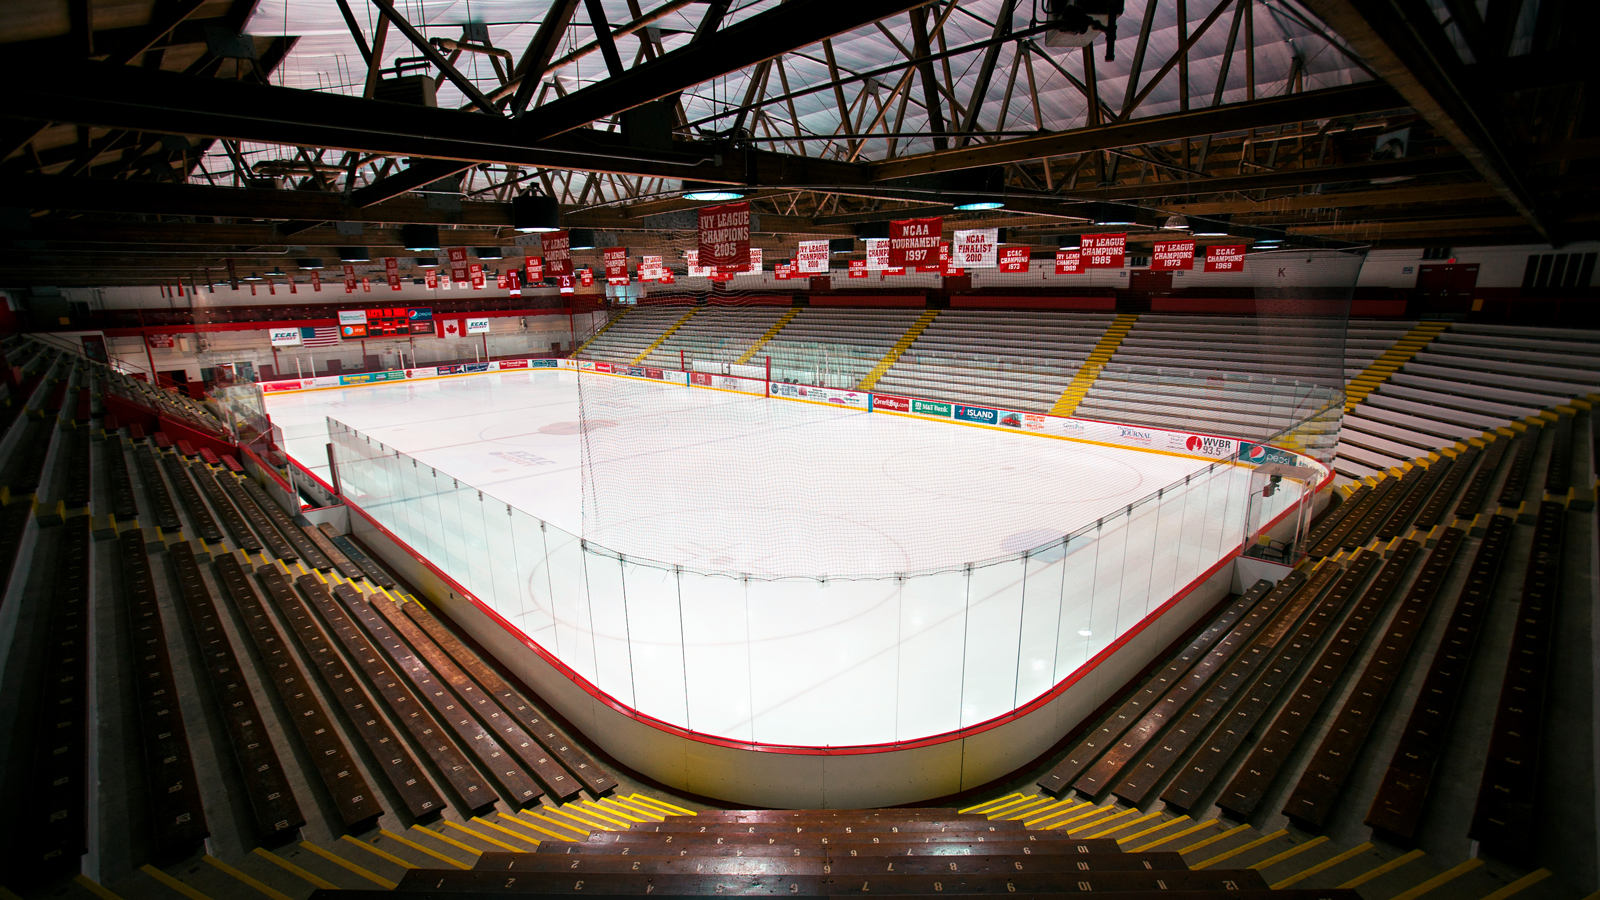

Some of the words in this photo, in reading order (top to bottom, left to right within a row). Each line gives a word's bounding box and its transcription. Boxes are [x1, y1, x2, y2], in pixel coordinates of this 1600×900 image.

[700, 215, 714, 229] IVY
[718, 211, 750, 228] LEAGUE
[902, 224, 929, 236] NCAA
[702, 227, 749, 244] CHAMPIONS
[966, 235, 985, 243] NCAA
[892, 236, 941, 249] TOURNAMENT
[1082, 239, 1094, 247] IVY
[1096, 238, 1124, 246] LEAGUE
[714, 242, 736, 257] 2005
[958, 244, 993, 253] FINALIST
[1082, 247, 1123, 256] CHAMPIONS
[800, 252, 828, 261] CHAMPIONS
[905, 250, 927, 261] 1997
[966, 254, 982, 262] 2010
[1092, 256, 1111, 264] 1985
[1154, 251, 1192, 260] CHAMPIONS
[1278, 268, 1286, 277] K
[967, 409, 994, 419] ISLAND
[1120, 429, 1151, 438] JOURNAL
[1203, 437, 1231, 449] WVBR
[1203, 446, 1221, 456] 93.5
[571, 860, 580, 869] 2
[632, 861, 640, 870] 3
[824, 865, 831, 874] 6
[950, 862, 958, 871] 8
[1015, 861, 1023, 870] 9
[1076, 862, 1090, 871] 10
[1143, 860, 1152, 870] 11
[505, 878, 516, 888] 2
[574, 880, 585, 890] 3
[934, 882, 943, 892] 8
[1007, 882, 1016, 893] 9
[1078, 881, 1092, 891] 10
[1157, 880, 1168, 890] 11
[1222, 880, 1239, 891] 12
